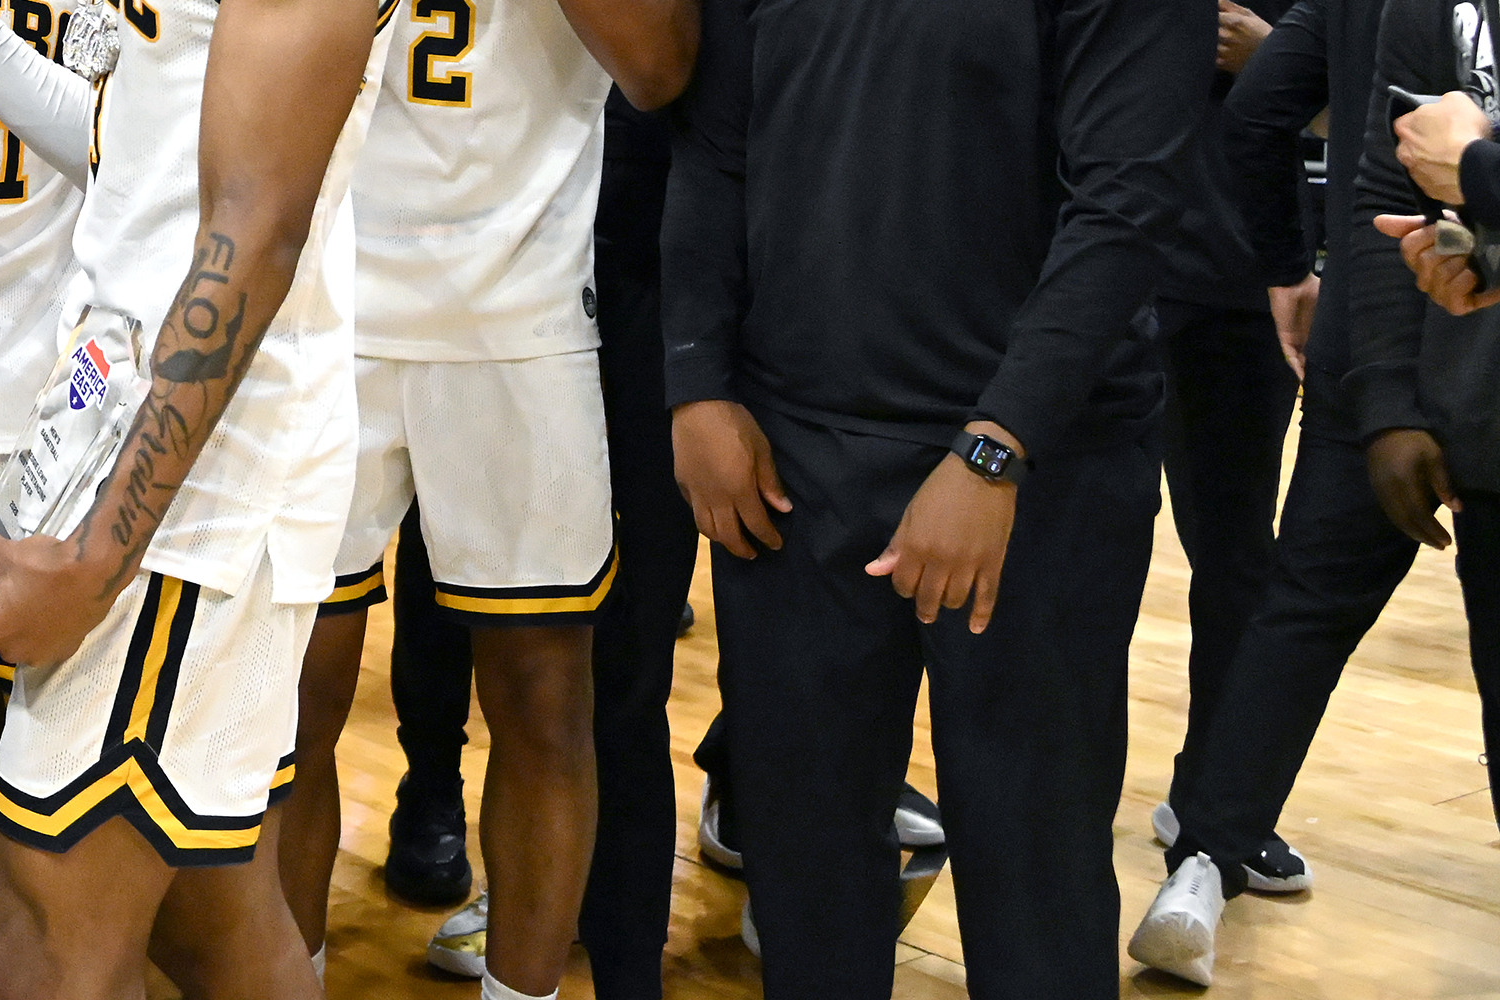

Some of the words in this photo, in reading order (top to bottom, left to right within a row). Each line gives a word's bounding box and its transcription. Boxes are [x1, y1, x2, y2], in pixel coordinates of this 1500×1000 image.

[71, 346, 107, 405] AMERICA
[73, 367, 94, 402] EAST
[40, 428, 59, 462] BASKETBALL
[50, 426, 61, 445] MEN'S
[21, 475, 33, 496] PLAYER
[25, 466, 47, 502] OUTSTANDING
[36, 469, 48, 486] LEWIS
